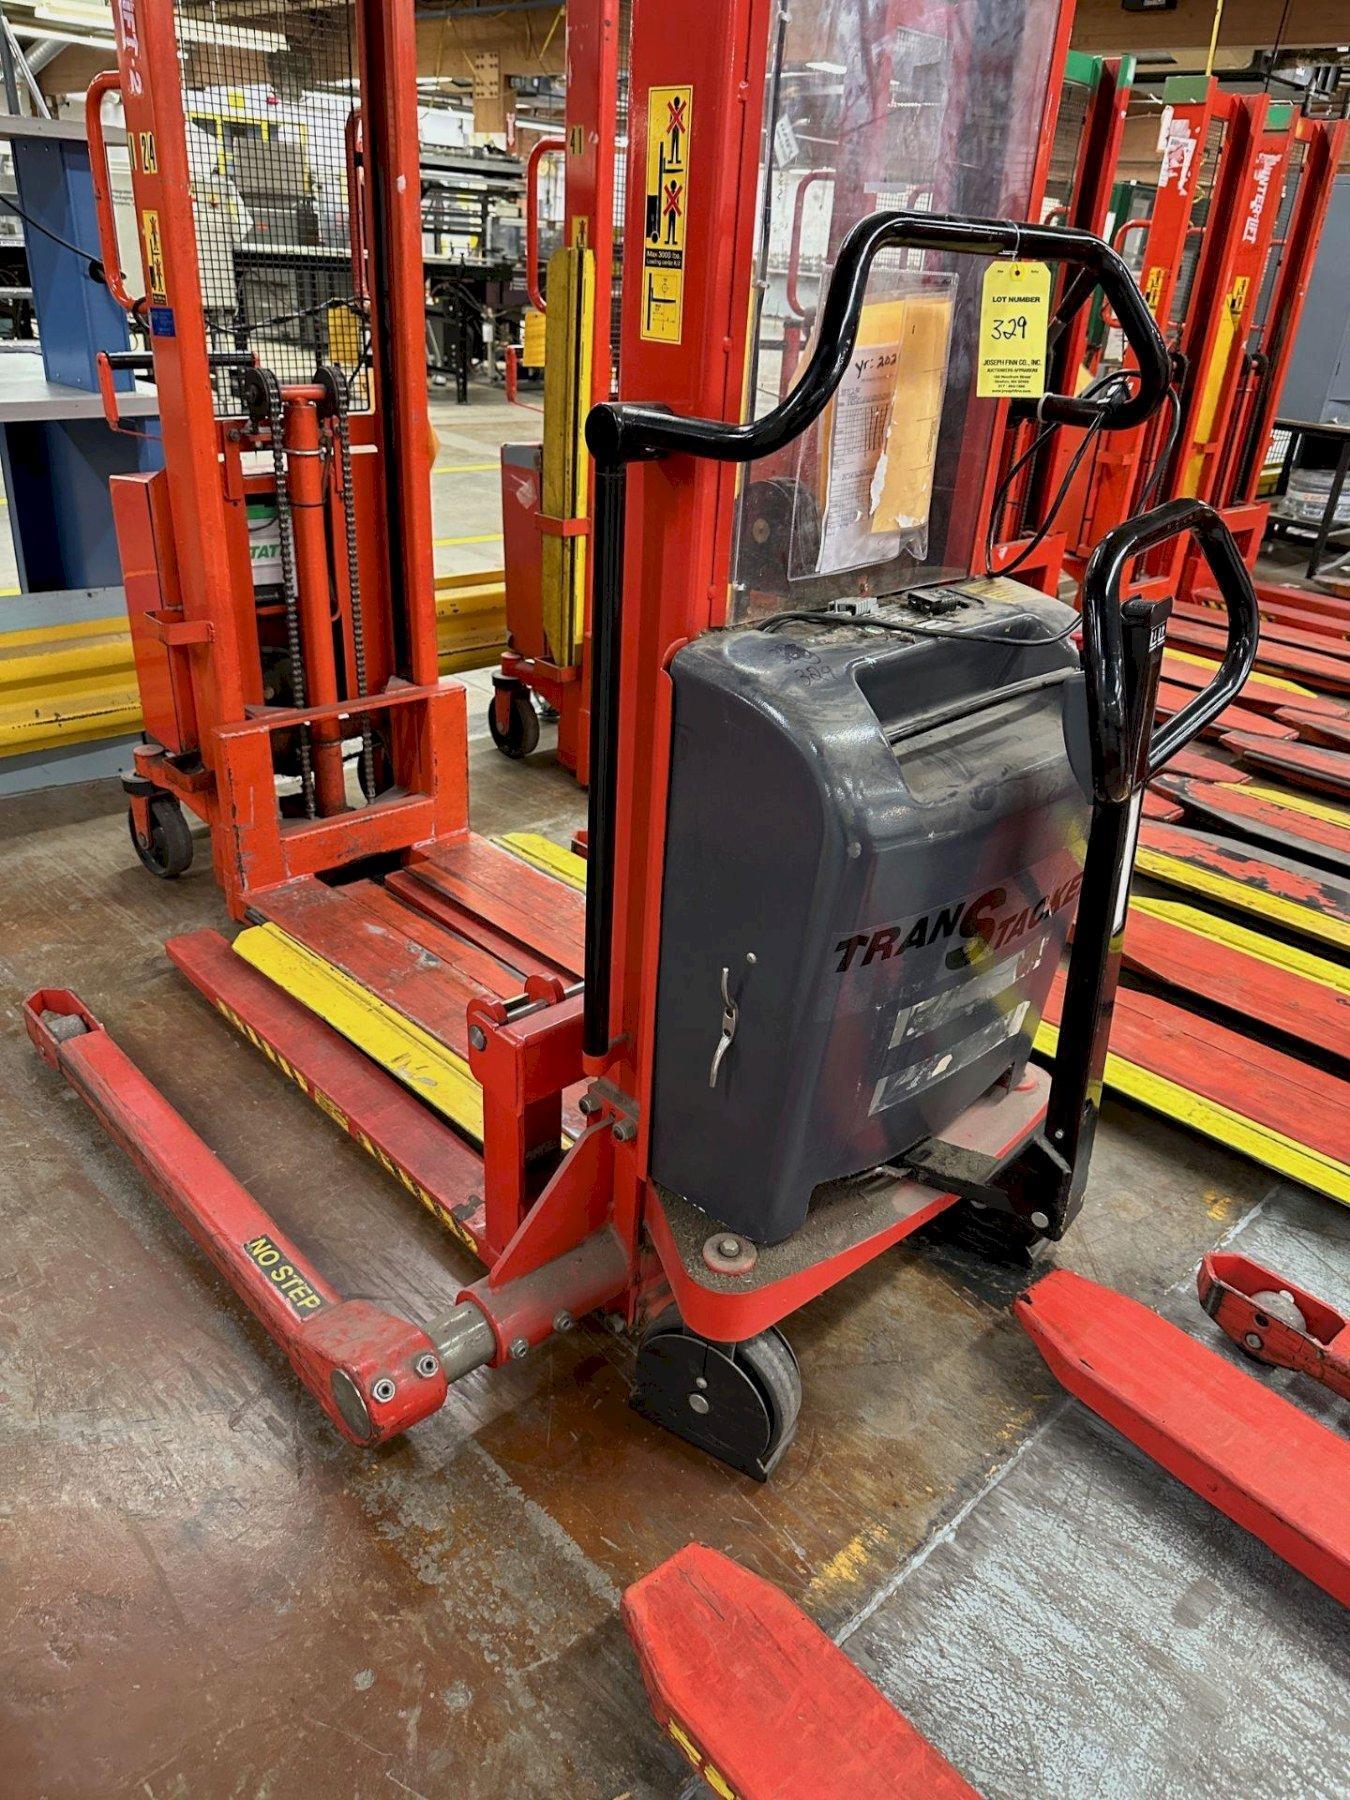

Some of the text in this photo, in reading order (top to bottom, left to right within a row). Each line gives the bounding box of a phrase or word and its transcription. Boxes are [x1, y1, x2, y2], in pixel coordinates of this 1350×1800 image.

[991, 315, 1027, 340] 329
[833, 870, 1085, 973] TRANSTACKE
[249, 1237, 321, 1309] NO STEP
